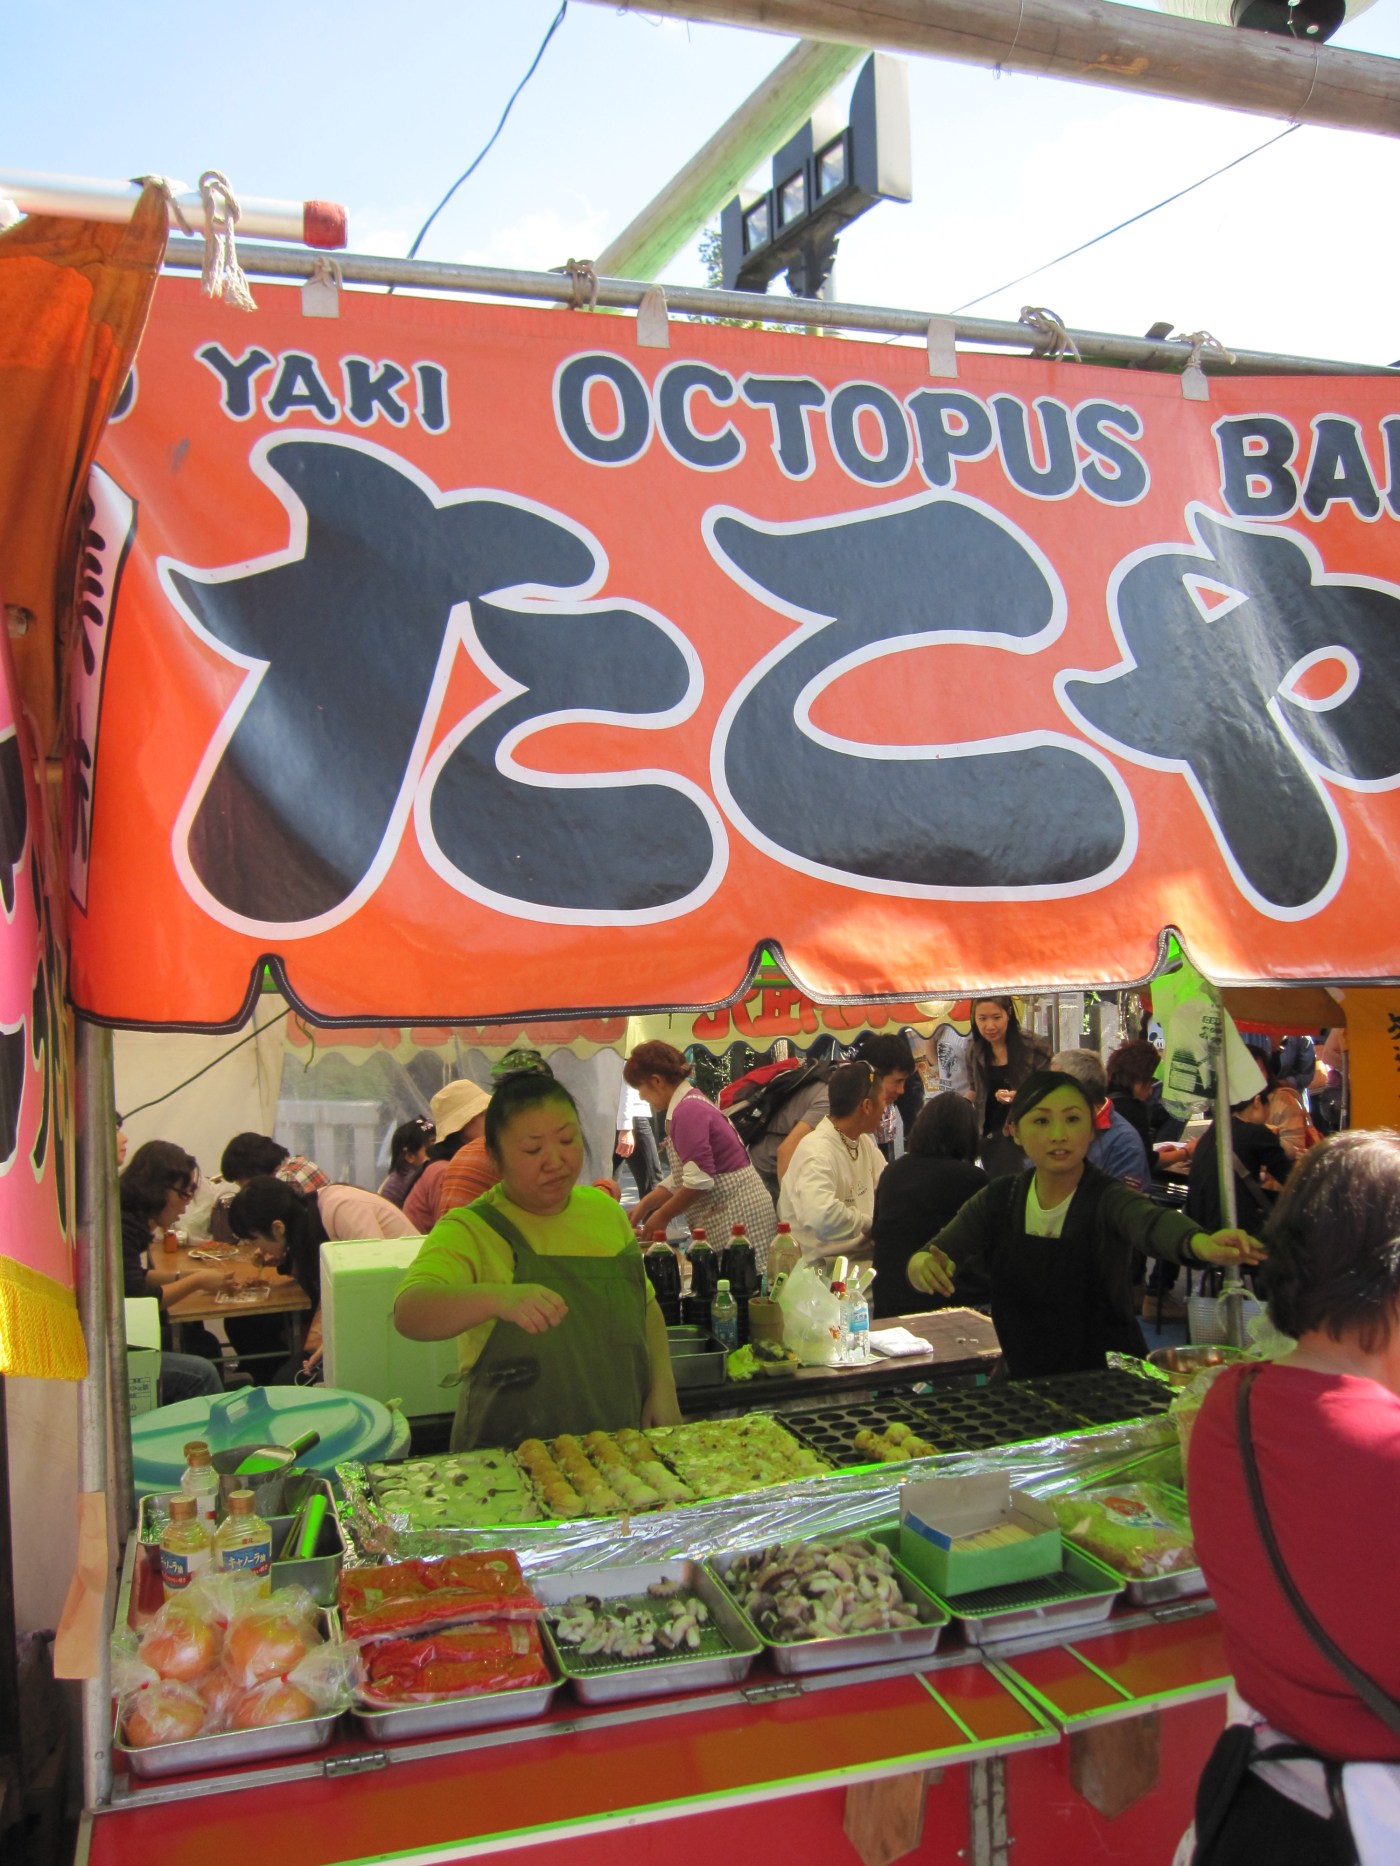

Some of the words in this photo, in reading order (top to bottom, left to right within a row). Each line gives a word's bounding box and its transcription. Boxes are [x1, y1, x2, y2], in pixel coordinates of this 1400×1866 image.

[196, 342, 450, 434] YAKI
[552, 350, 1151, 507] OCTOPUS
[1210, 412, 1400, 523] BA
